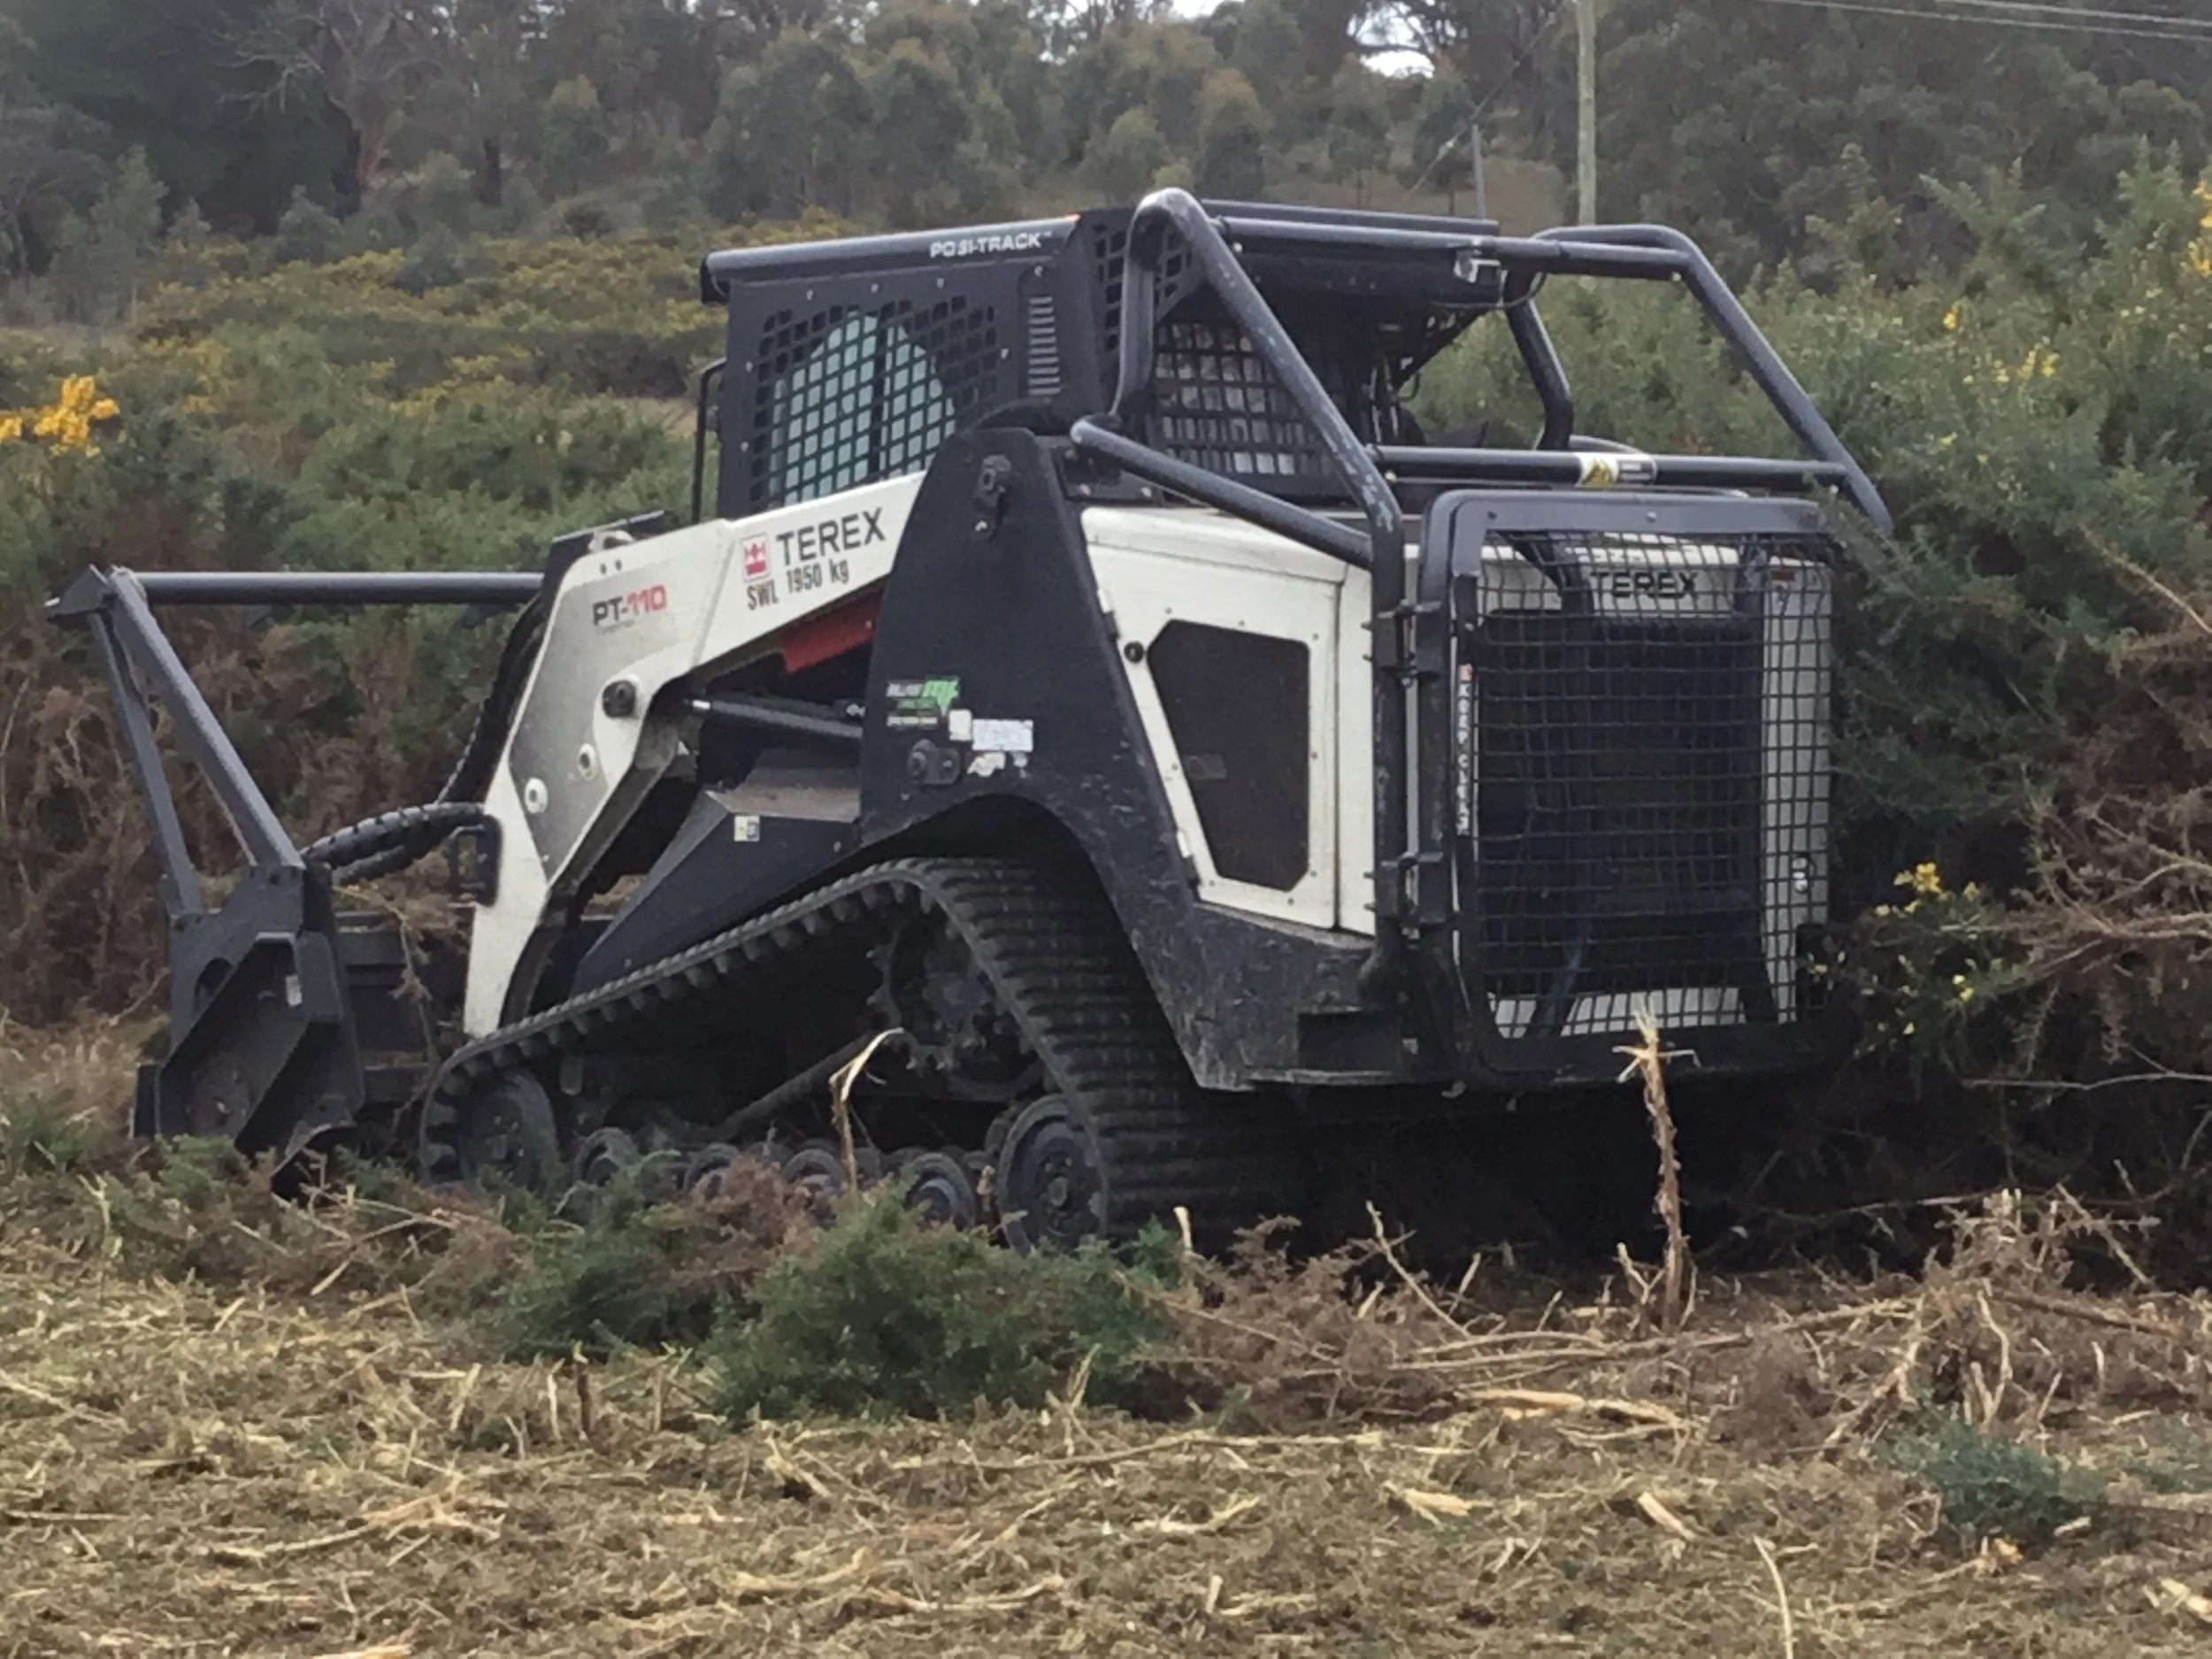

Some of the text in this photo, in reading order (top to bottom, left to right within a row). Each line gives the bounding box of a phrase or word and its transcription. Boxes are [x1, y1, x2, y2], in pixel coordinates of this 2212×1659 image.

[930, 232, 1041, 258] POSI-TRACK
[776, 506, 886, 566] TEREX
[593, 584, 667, 626] PT-110
[747, 558, 849, 611] SWL 1950 kg
[1590, 571, 1698, 598] TEREX
